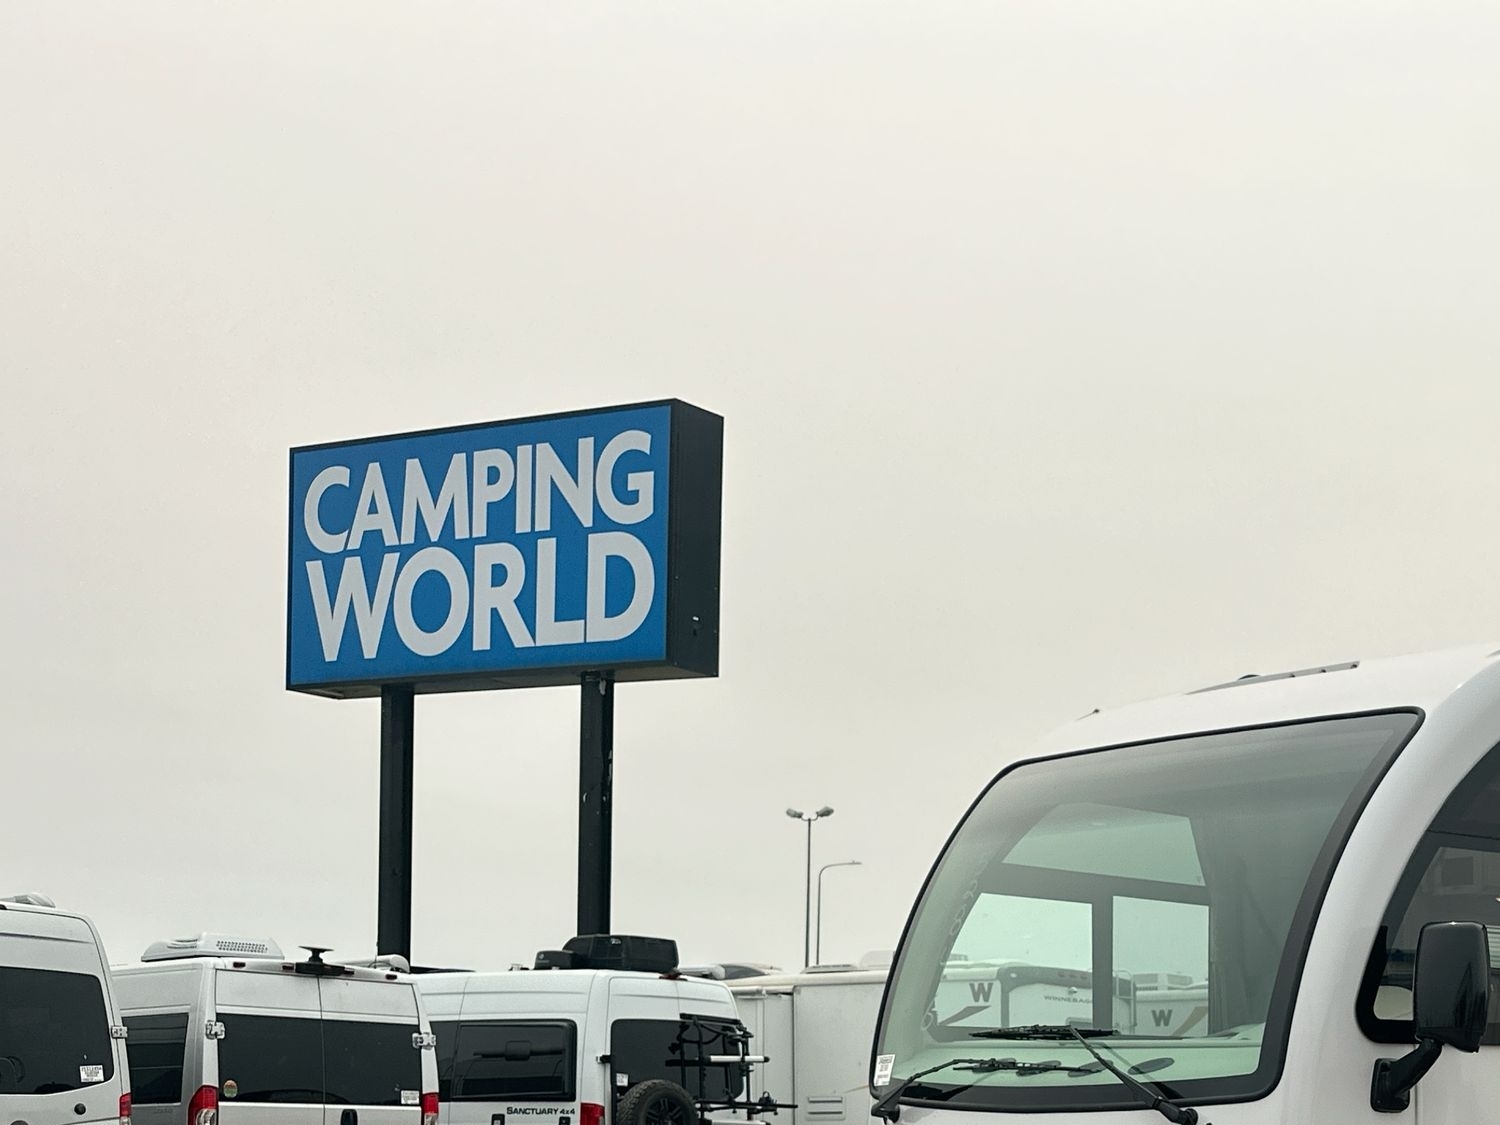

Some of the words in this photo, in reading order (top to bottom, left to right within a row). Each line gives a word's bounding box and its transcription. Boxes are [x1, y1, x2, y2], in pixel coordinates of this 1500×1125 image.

[303, 429, 655, 554] CAMPING
[305, 530, 656, 662] WORLD
[969, 982, 993, 1003] W
[1043, 995, 1091, 1004] WINNEBAG
[1151, 1009, 1173, 1027] W
[506, 1106, 559, 1115] SANCTUARY
